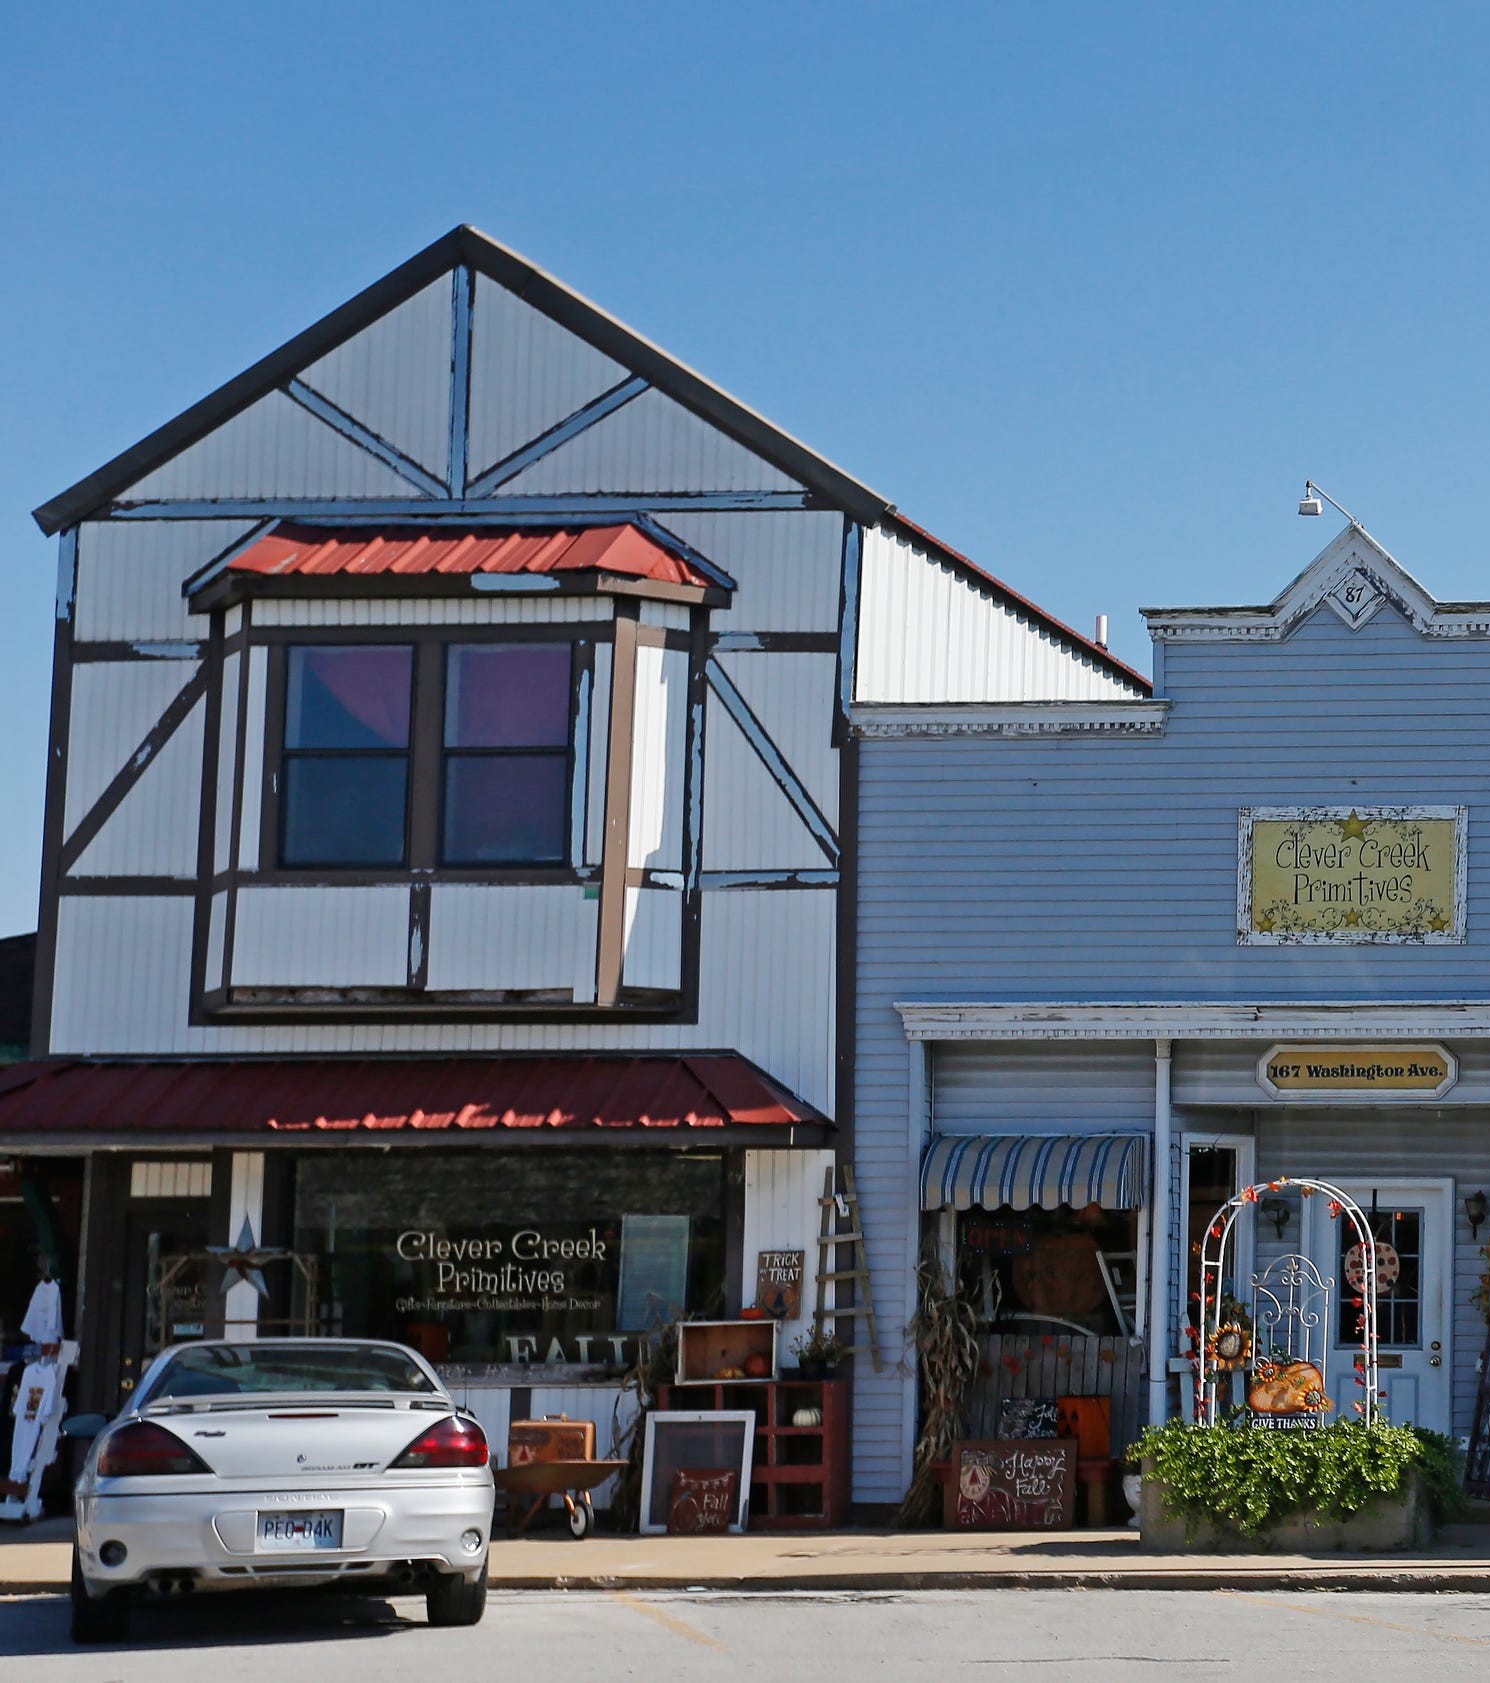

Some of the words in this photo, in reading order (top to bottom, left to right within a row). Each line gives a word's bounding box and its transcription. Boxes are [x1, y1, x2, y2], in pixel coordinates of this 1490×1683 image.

[1346, 584, 1366, 603] 87
[1275, 833, 1351, 869] Clever
[1359, 832, 1431, 871] Creek
[1292, 871, 1413, 906] Primitives
[1270, 1064, 1301, 1078] 167
[1306, 1063, 1404, 1080] Washington
[1408, 1063, 1443, 1077] Ave.
[397, 1230, 502, 1261] Clever
[511, 1228, 606, 1261] Creek
[968, 1228, 1027, 1249] OPEN
[437, 1262, 565, 1294] Primitives
[769, 1267, 801, 1282] TREAT
[1251, 1418, 1274, 1430] GIVE
[1277, 1418, 1316, 1430] THANKS
[1005, 1453, 1066, 1480] Happy
[1016, 1478, 1051, 1497] Fall
[703, 1493, 729, 1511] Fall
